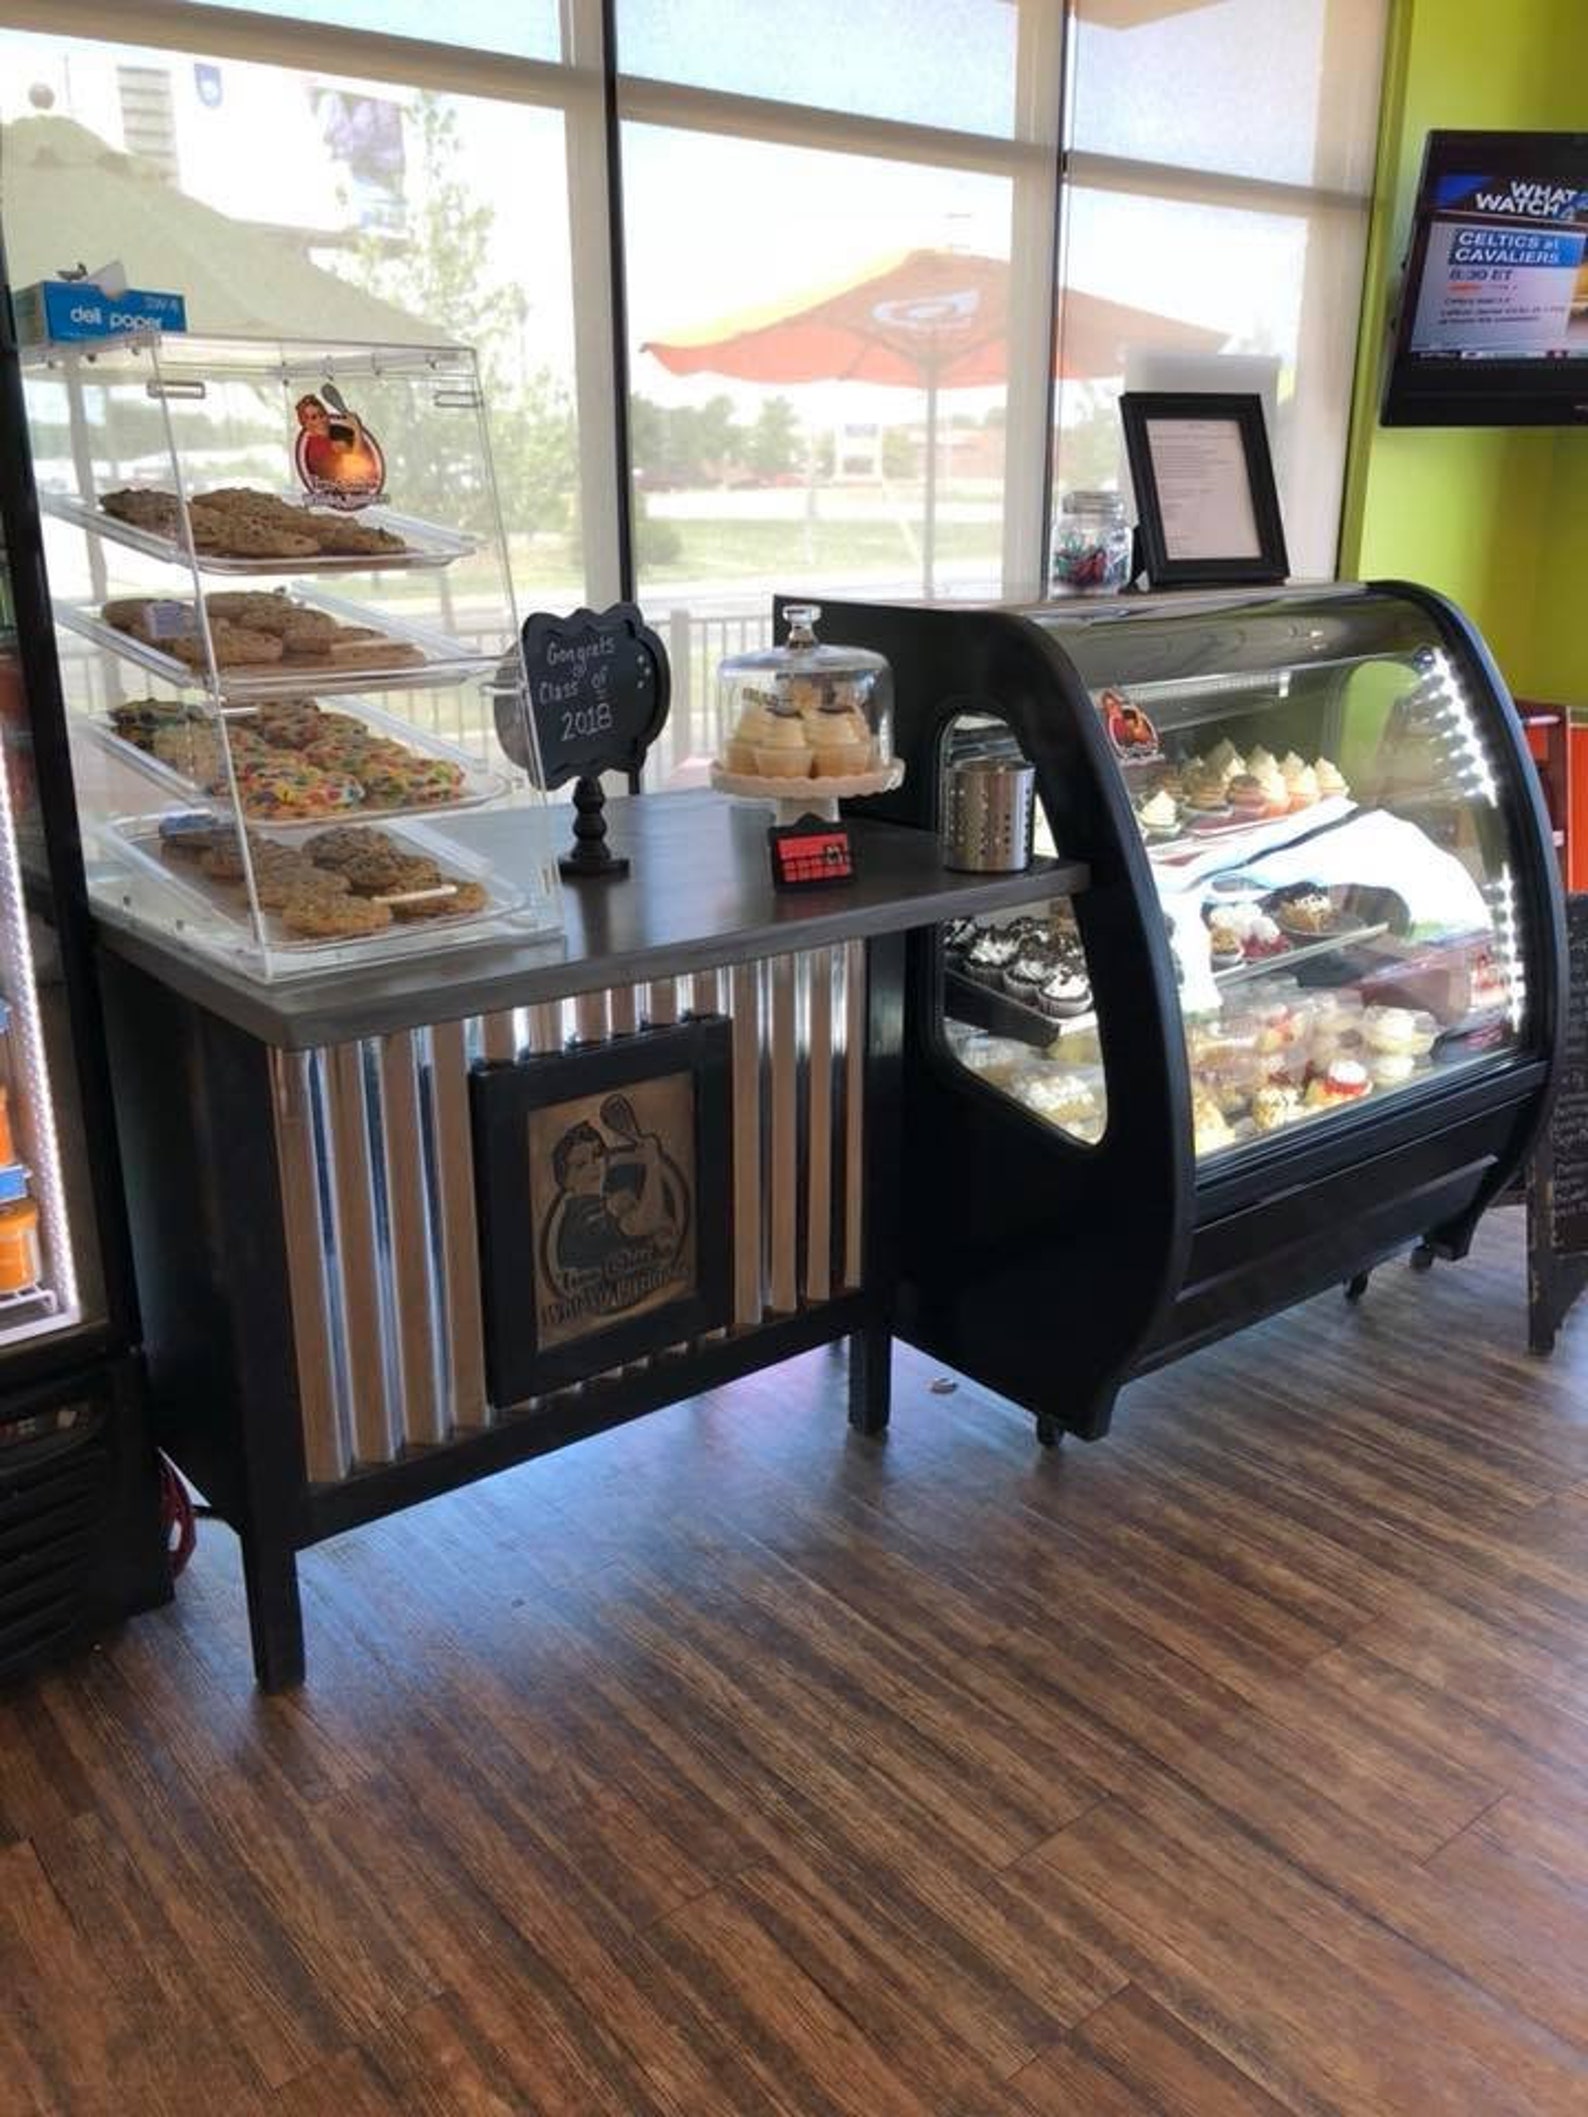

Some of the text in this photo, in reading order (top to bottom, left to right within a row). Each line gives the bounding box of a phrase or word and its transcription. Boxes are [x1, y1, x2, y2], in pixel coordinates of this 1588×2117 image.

[1510, 181, 1577, 204] WHAT
[1475, 193, 1560, 216] WATCH
[1458, 231, 1538, 249] CELTICS
[1455, 248, 1560, 264] CAVALIERS
[70, 305, 102, 325] deli
[538, 681, 579, 705] Class
[560, 702, 613, 742] 2018
